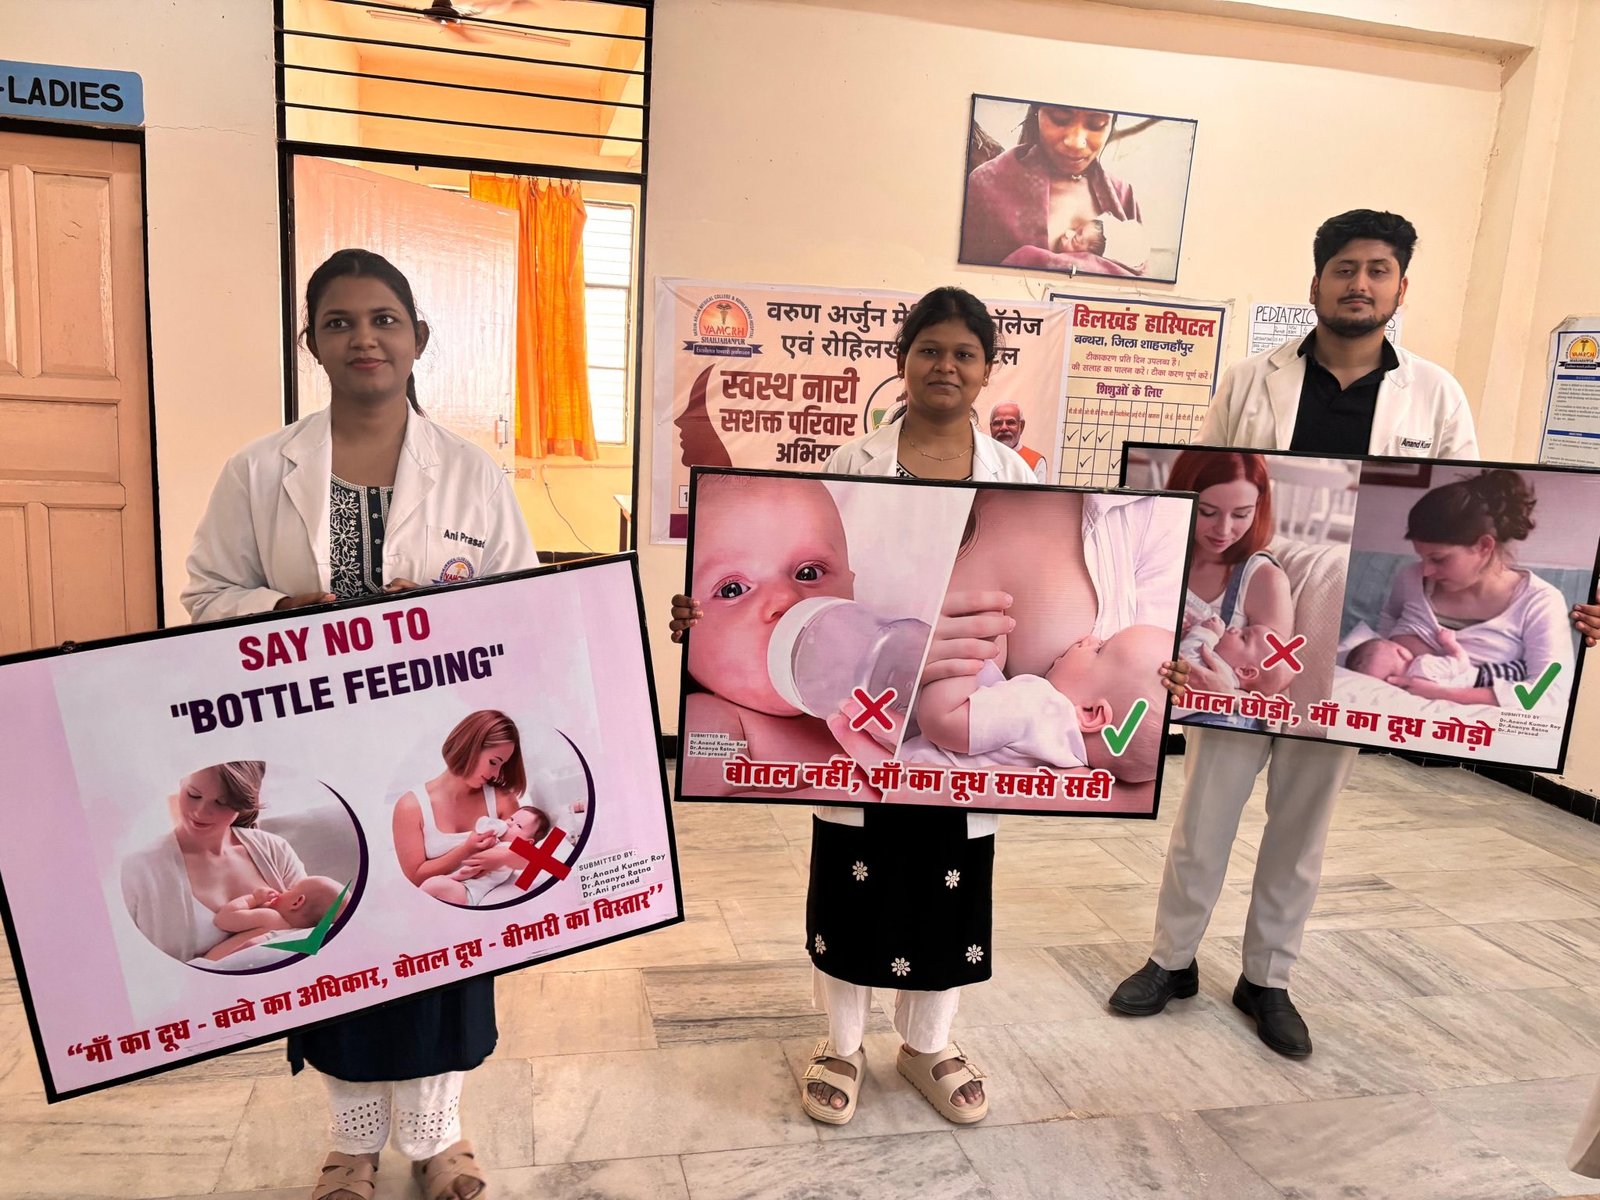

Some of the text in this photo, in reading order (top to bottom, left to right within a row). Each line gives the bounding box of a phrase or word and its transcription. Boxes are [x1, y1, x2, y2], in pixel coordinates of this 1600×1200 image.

[767, 302, 822, 323] वरुण
[827, 301, 887, 333] अर्जुन
[1072, 303, 1140, 331] हिलखंड
[781, 330, 898, 361] एवं रोहिलख
[1111, 334, 1138, 348] जिला
[1140, 340, 1195, 356] शाहजहाँपुर
[1083, 364, 1101, 372] सलाह
[1104, 365, 1112, 373] का
[1114, 366, 1133, 374] पालन
[1151, 366, 1166, 376] टीका
[720, 367, 860, 404] स्वस्थ नारी
[1096, 381, 1164, 398] शिशुओं के लिए
[719, 405, 858, 436] सशक्त परिवार
[775, 437, 842, 464] अभिय
[1401, 438, 1420, 449] Anand
[444, 529, 459, 541] Ani
[238, 607, 431, 671] SAY NO TO
[170, 643, 505, 735] "BOTTLE FEEDING"
[1346, 710, 1382, 732] का
[1387, 715, 1426, 744] दूध
[1432, 717, 1496, 751] जोड़ो
[725, 756, 799, 787] बोतल
[804, 758, 861, 793] नहीं,
[908, 769, 944, 791] का
[950, 771, 988, 801] दूध
[994, 768, 1058, 797] सबसे
[1064, 770, 1113, 799] सही
[578, 850, 637, 871] SUBMITTED BY:
[580, 853, 666, 882] Dr.Anand Kumar Roy
[581, 866, 652, 890] Dr.Ananya Ratna
[583, 876, 640, 898] Dr.Ani prasad
[117, 1029, 151, 1055] का
[155, 1019, 191, 1052] दूध
[213, 998, 256, 1030] बच्चे
[261, 991, 293, 1015] का
[297, 967, 388, 1007] अधिकार,
[392, 947, 449, 979] बोतल
[453, 939, 484, 969] दूध
[501, 913, 560, 949] बीमारी
[564, 908, 590, 931] का
